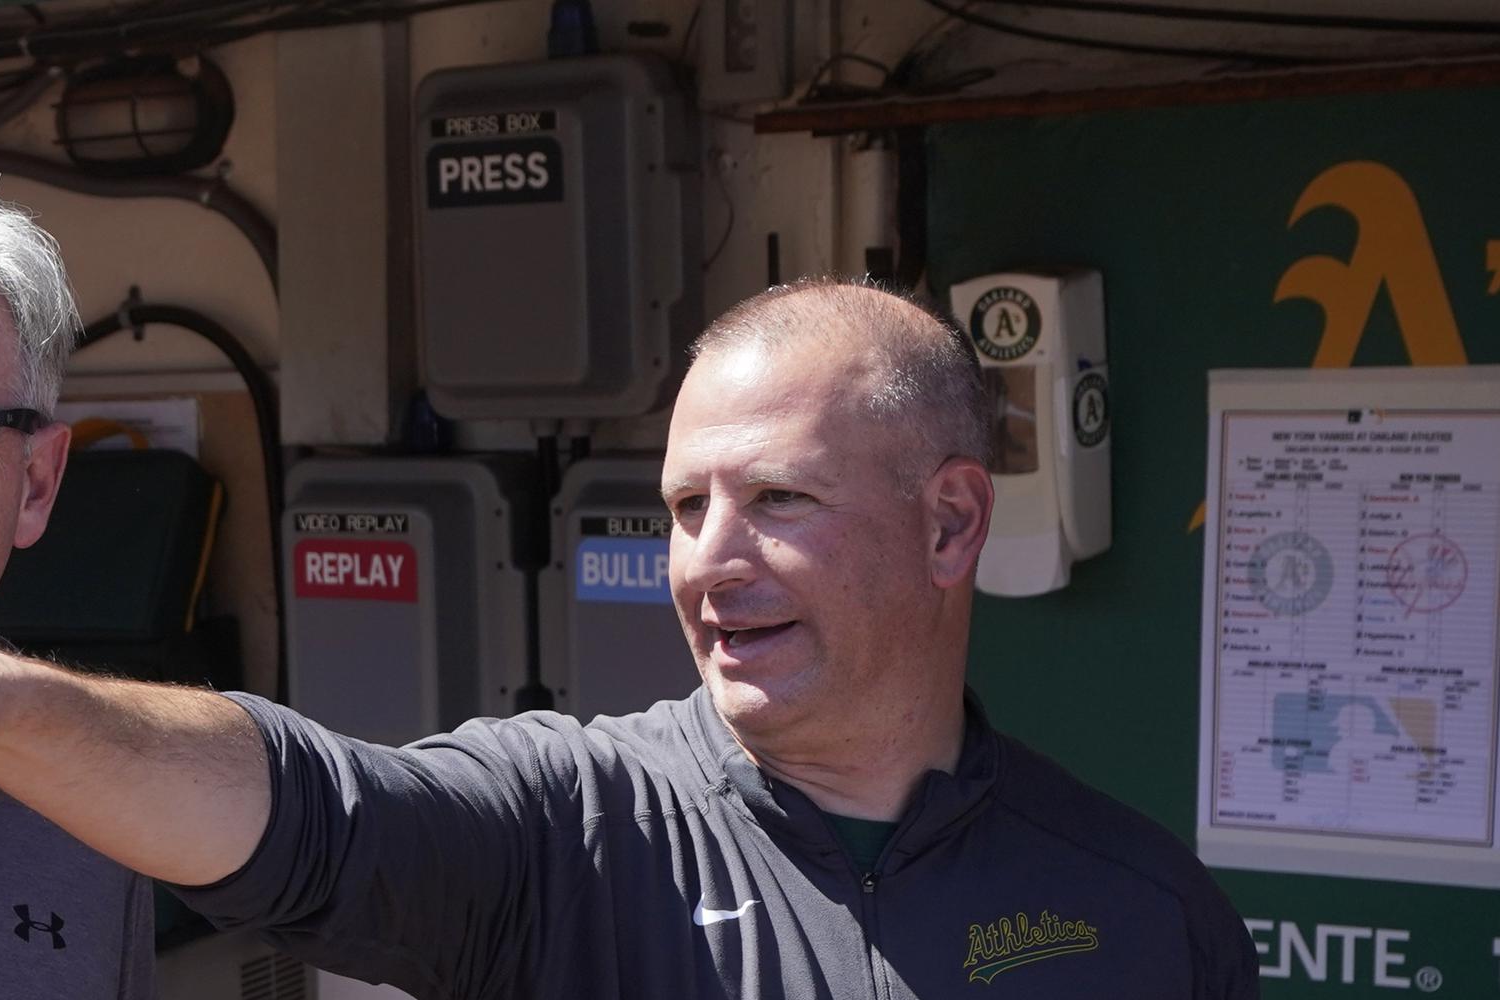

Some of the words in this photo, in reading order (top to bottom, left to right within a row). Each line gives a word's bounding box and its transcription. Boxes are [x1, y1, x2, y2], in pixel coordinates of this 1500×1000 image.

[445, 115, 499, 134] PRESS
[505, 113, 542, 131] BOX
[439, 151, 550, 194] PRESS
[298, 514, 341, 530] VIDEO
[346, 514, 406, 531] REPLAY
[607, 517, 670, 535] BULLPE
[306, 551, 404, 587] REPLAY
[582, 551, 669, 588] BULLP
[963, 910, 1092, 969] Athletics
